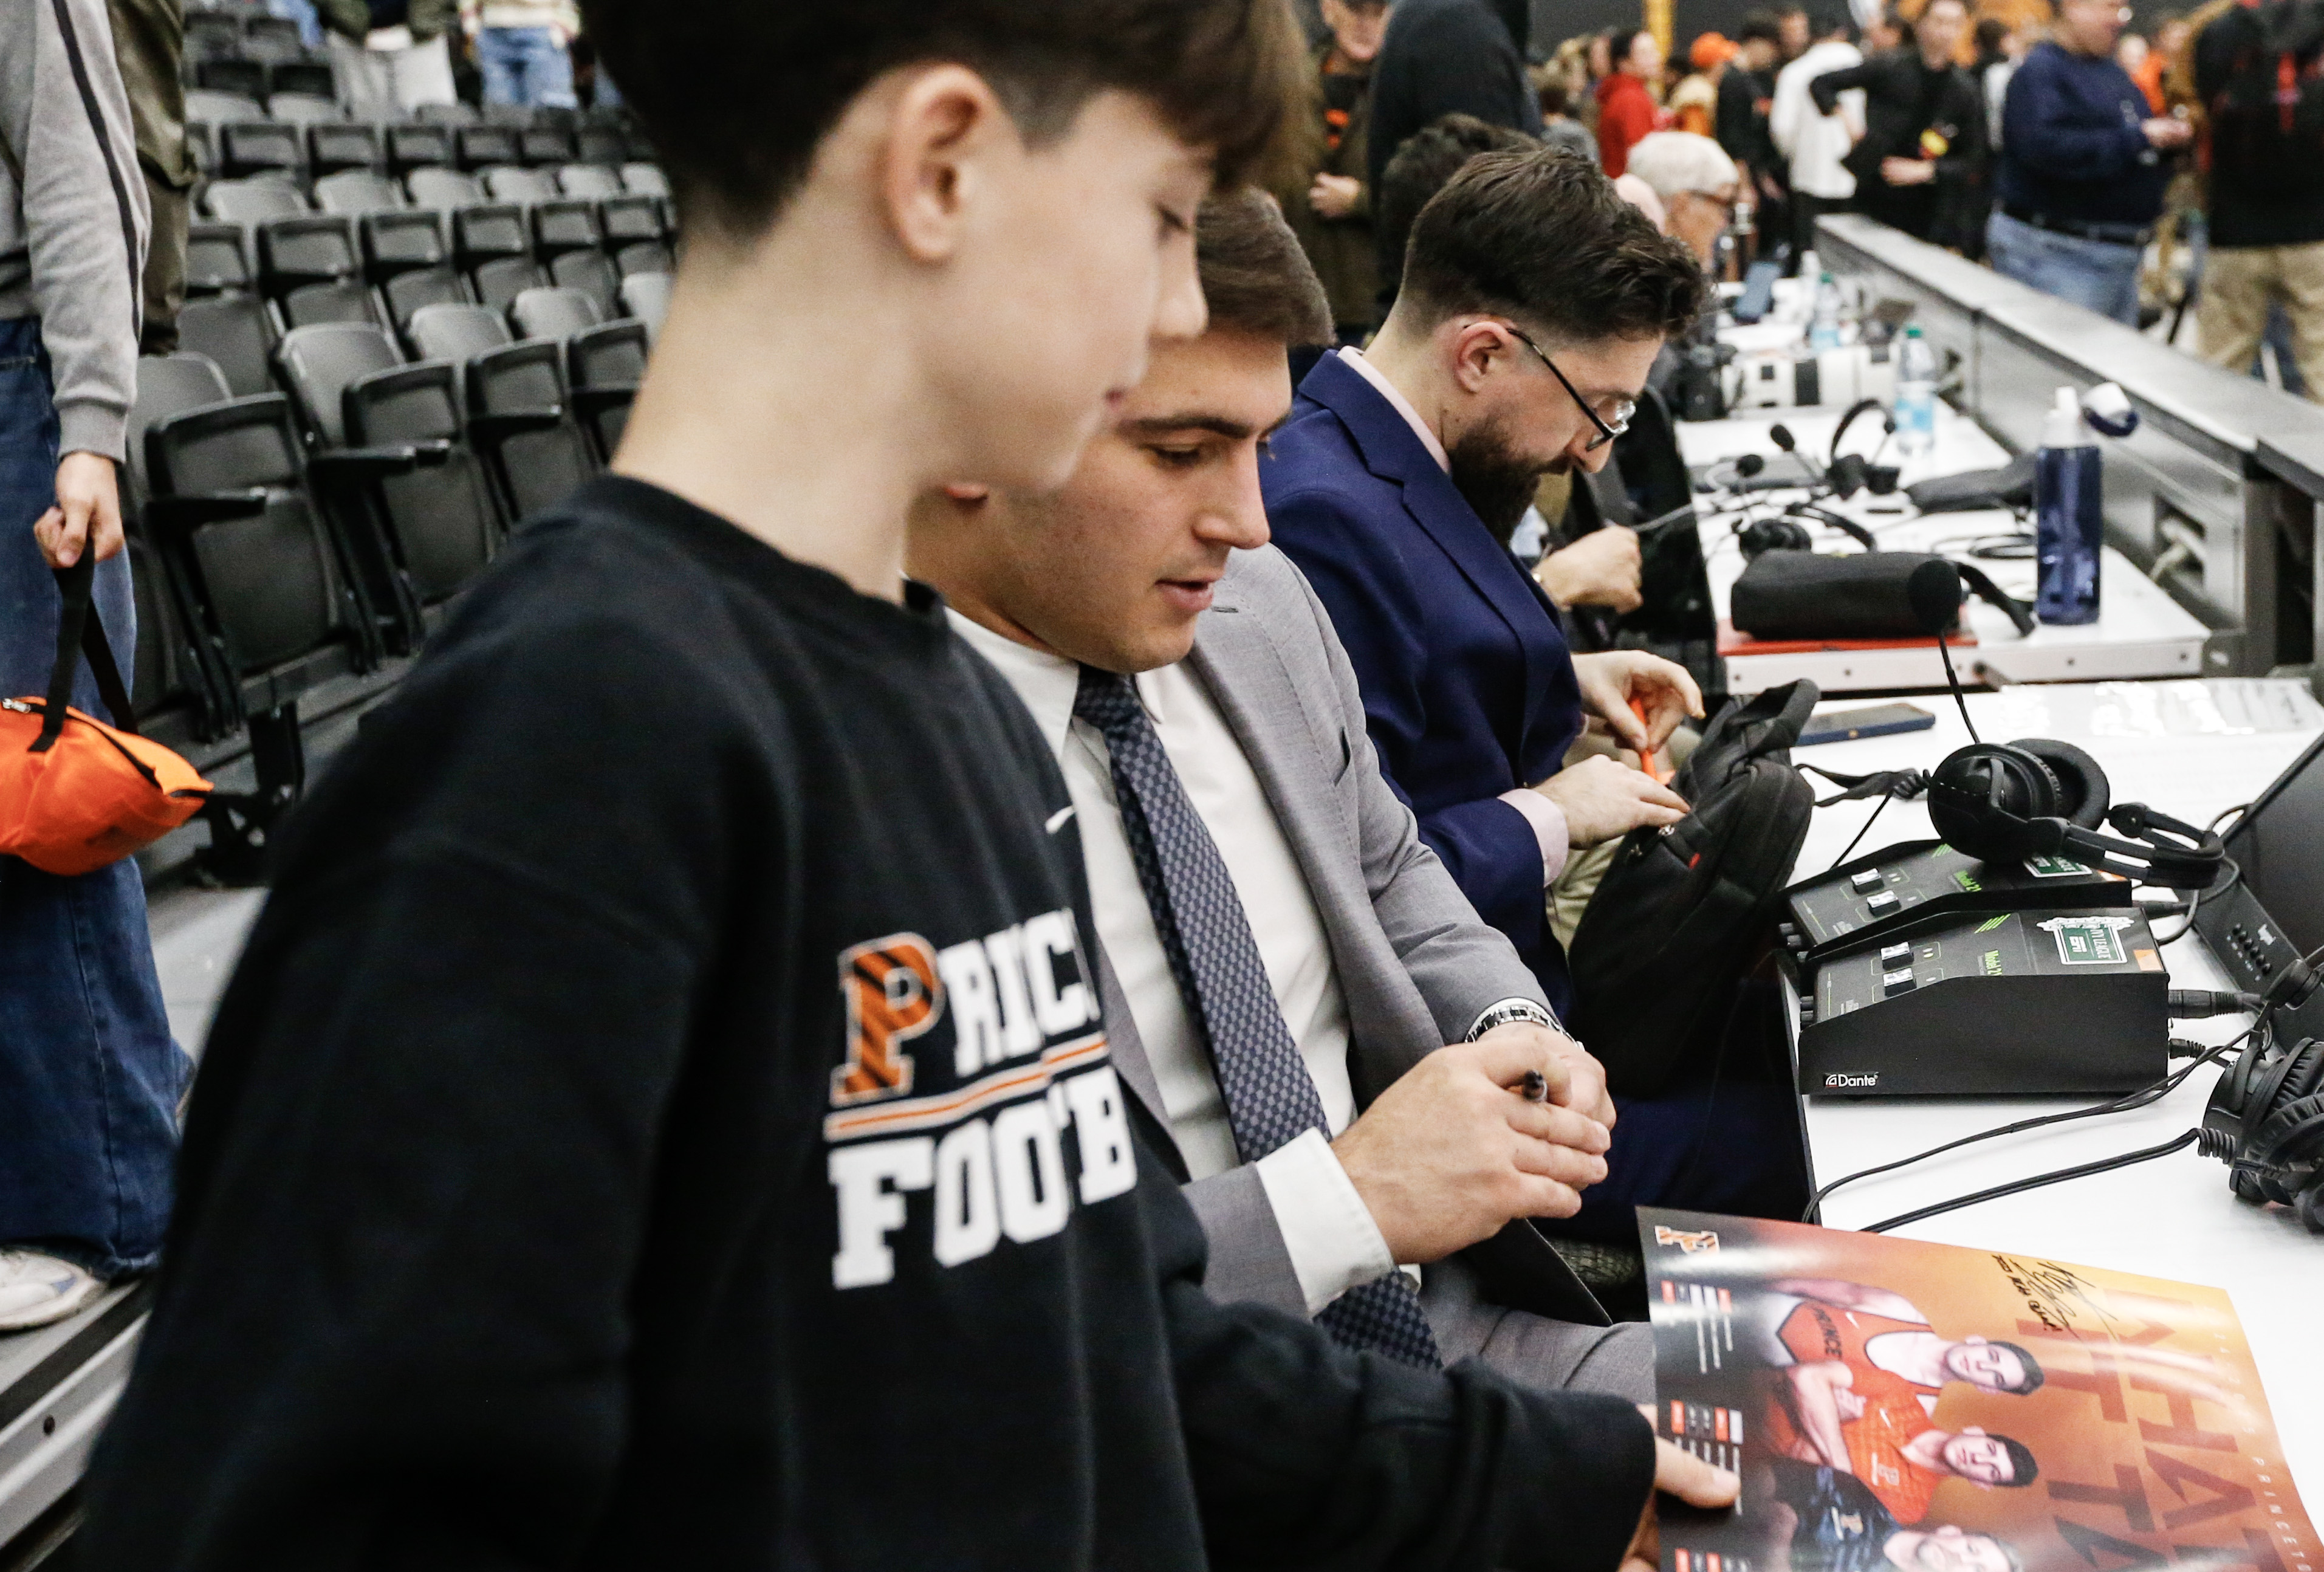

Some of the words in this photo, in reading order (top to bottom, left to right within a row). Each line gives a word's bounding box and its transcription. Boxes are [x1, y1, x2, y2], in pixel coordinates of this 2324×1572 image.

[2090, 929, 2105, 938] IVY
[2069, 936, 2088, 953] ESPN
[2093, 938, 2111, 959] LEAGUE
[1984, 950, 2001, 969] Model
[1838, 1074, 1876, 1087] Dante
[828, 1065, 1138, 1290] FOOB
[2015, 1318, 2128, 1424] IT
